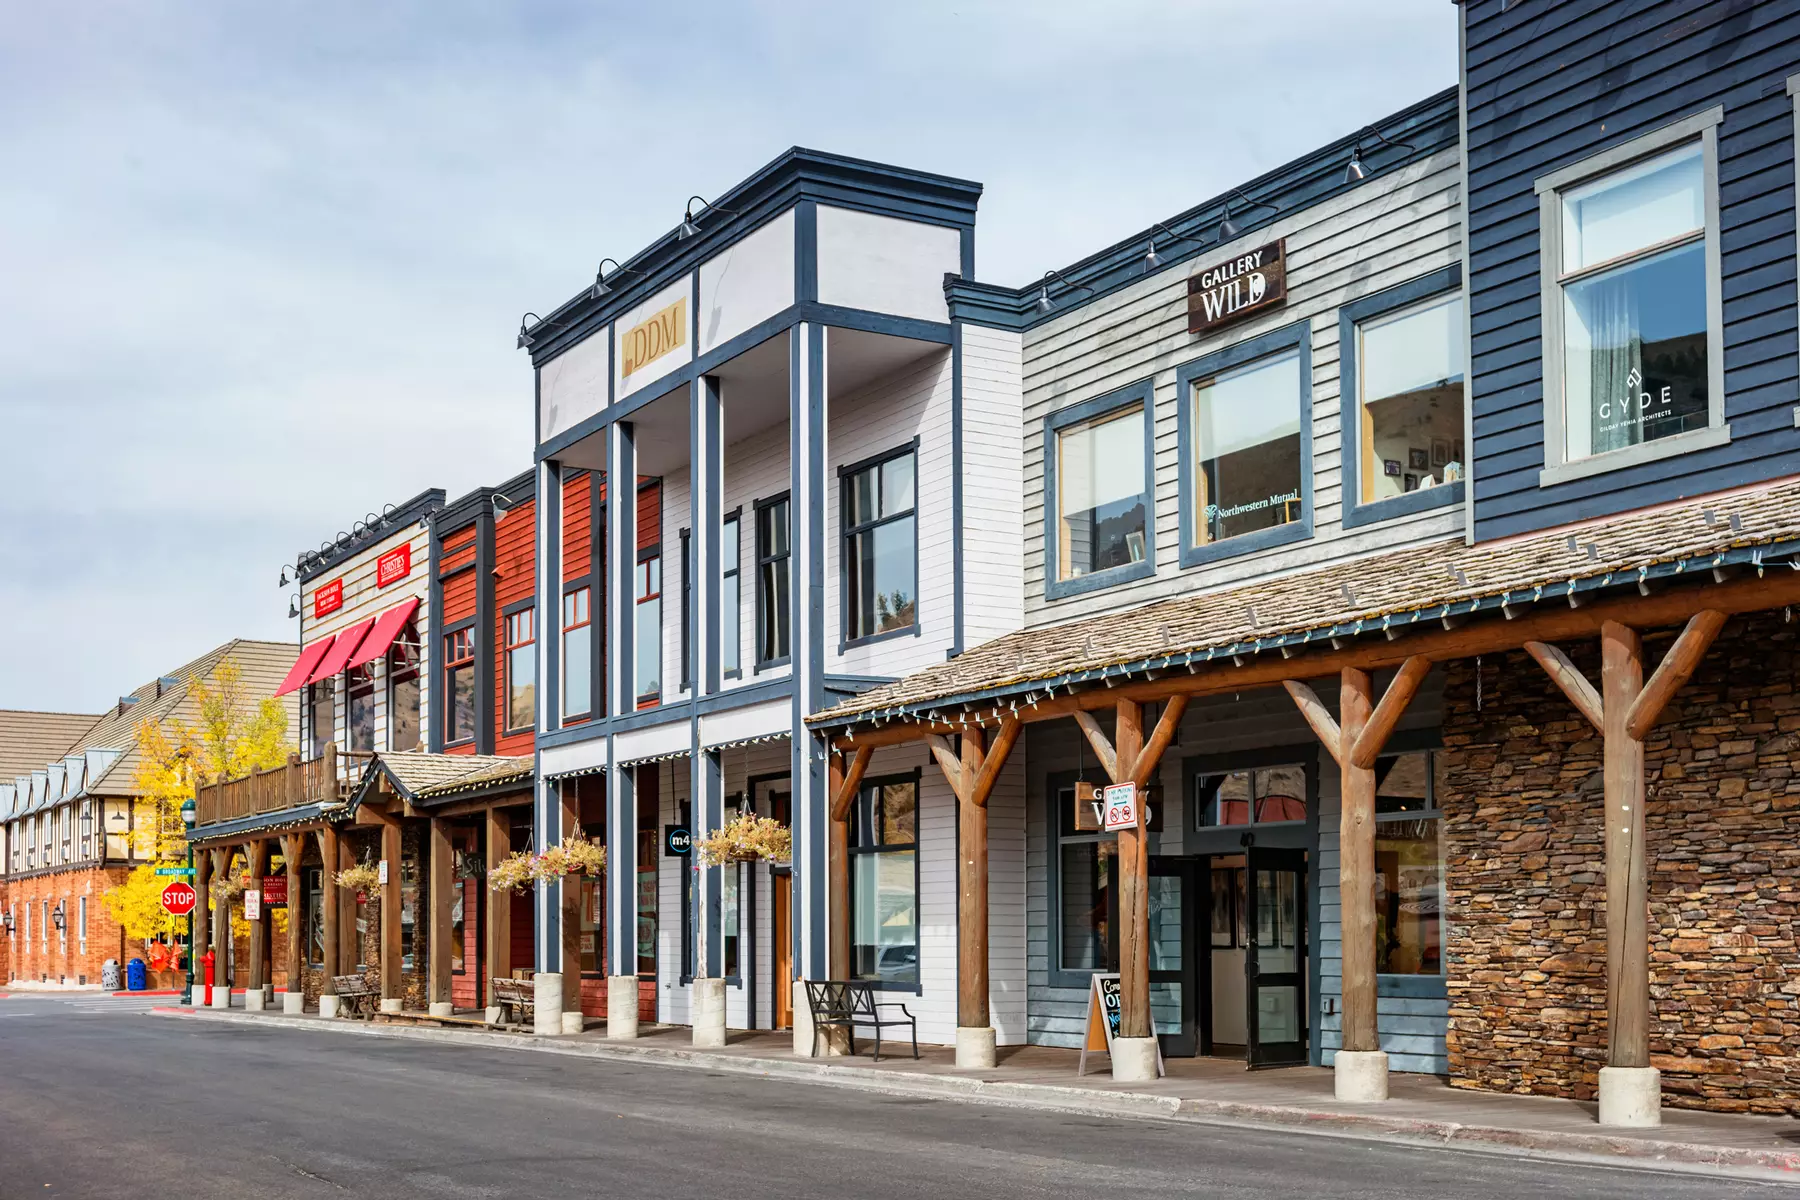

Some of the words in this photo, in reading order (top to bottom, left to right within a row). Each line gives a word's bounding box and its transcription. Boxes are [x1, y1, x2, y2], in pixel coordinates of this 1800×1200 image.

[1201, 250, 1263, 289] GALLERY
[1200, 272, 1266, 322] WILD
[633, 306, 679, 370] DDM
[1599, 385, 1672, 419] GYDE
[1600, 423, 1619, 433] GILDAY
[1620, 418, 1637, 428] YEHIA
[1638, 409, 1672, 423] ARCHITECTS
[1217, 498, 1269, 519] Northwestern
[1269, 488, 1298, 506] Mutual
[672, 835, 691, 846] m4
[164, 892, 194, 905] STOP
